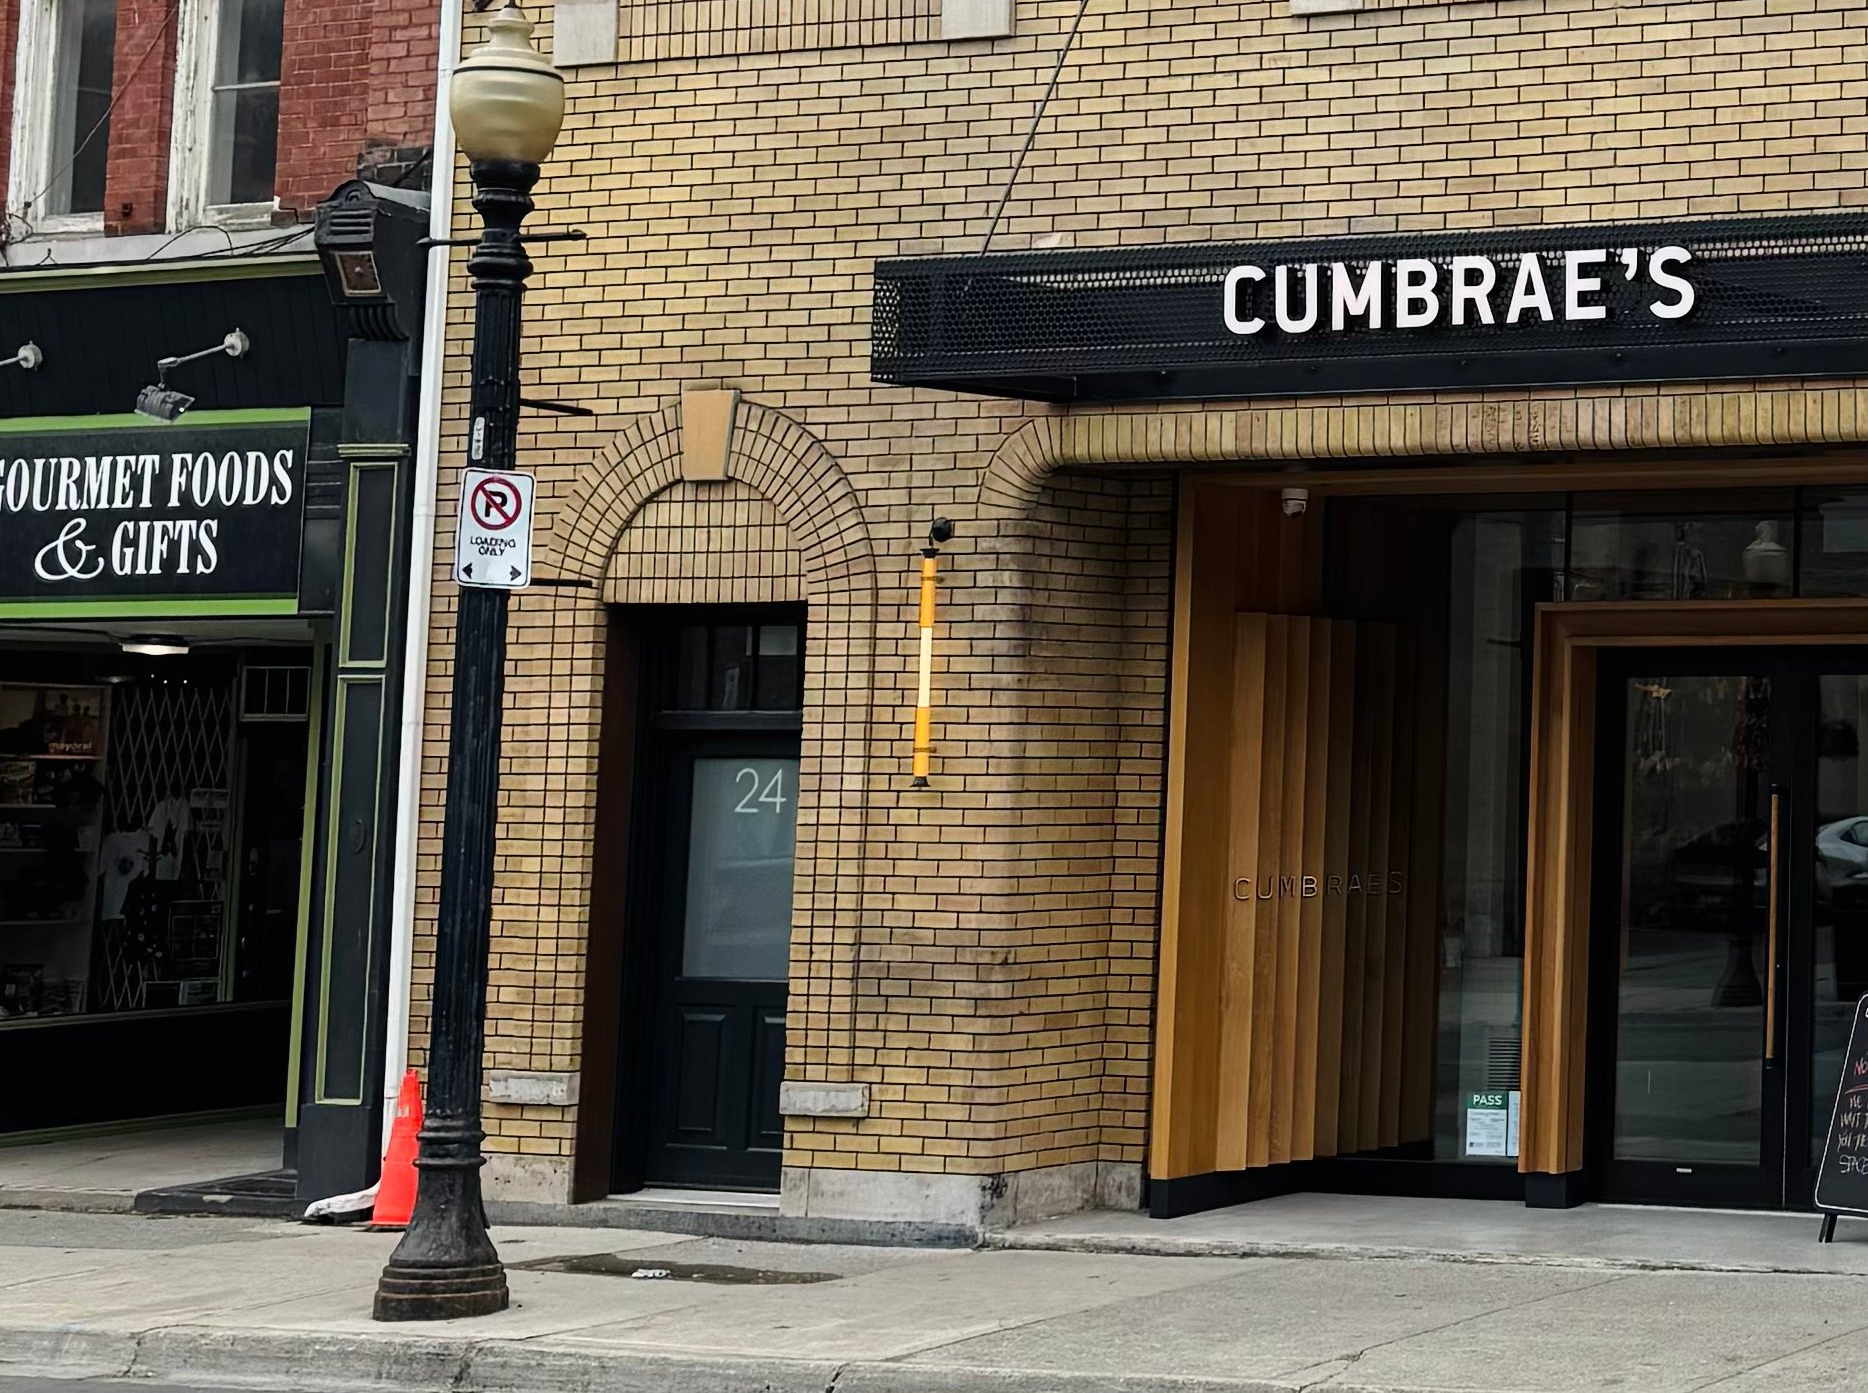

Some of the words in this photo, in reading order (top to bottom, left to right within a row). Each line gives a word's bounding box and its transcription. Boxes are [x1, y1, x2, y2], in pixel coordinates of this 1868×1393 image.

[1223, 244, 1697, 335] CUMBRAE'S
[168, 448, 295, 507] FOODS
[33, 517, 105, 581] &
[111, 518, 219, 576] GIFTS
[734, 766, 787, 815] 24
[1472, 1094, 1503, 1106] PASS
